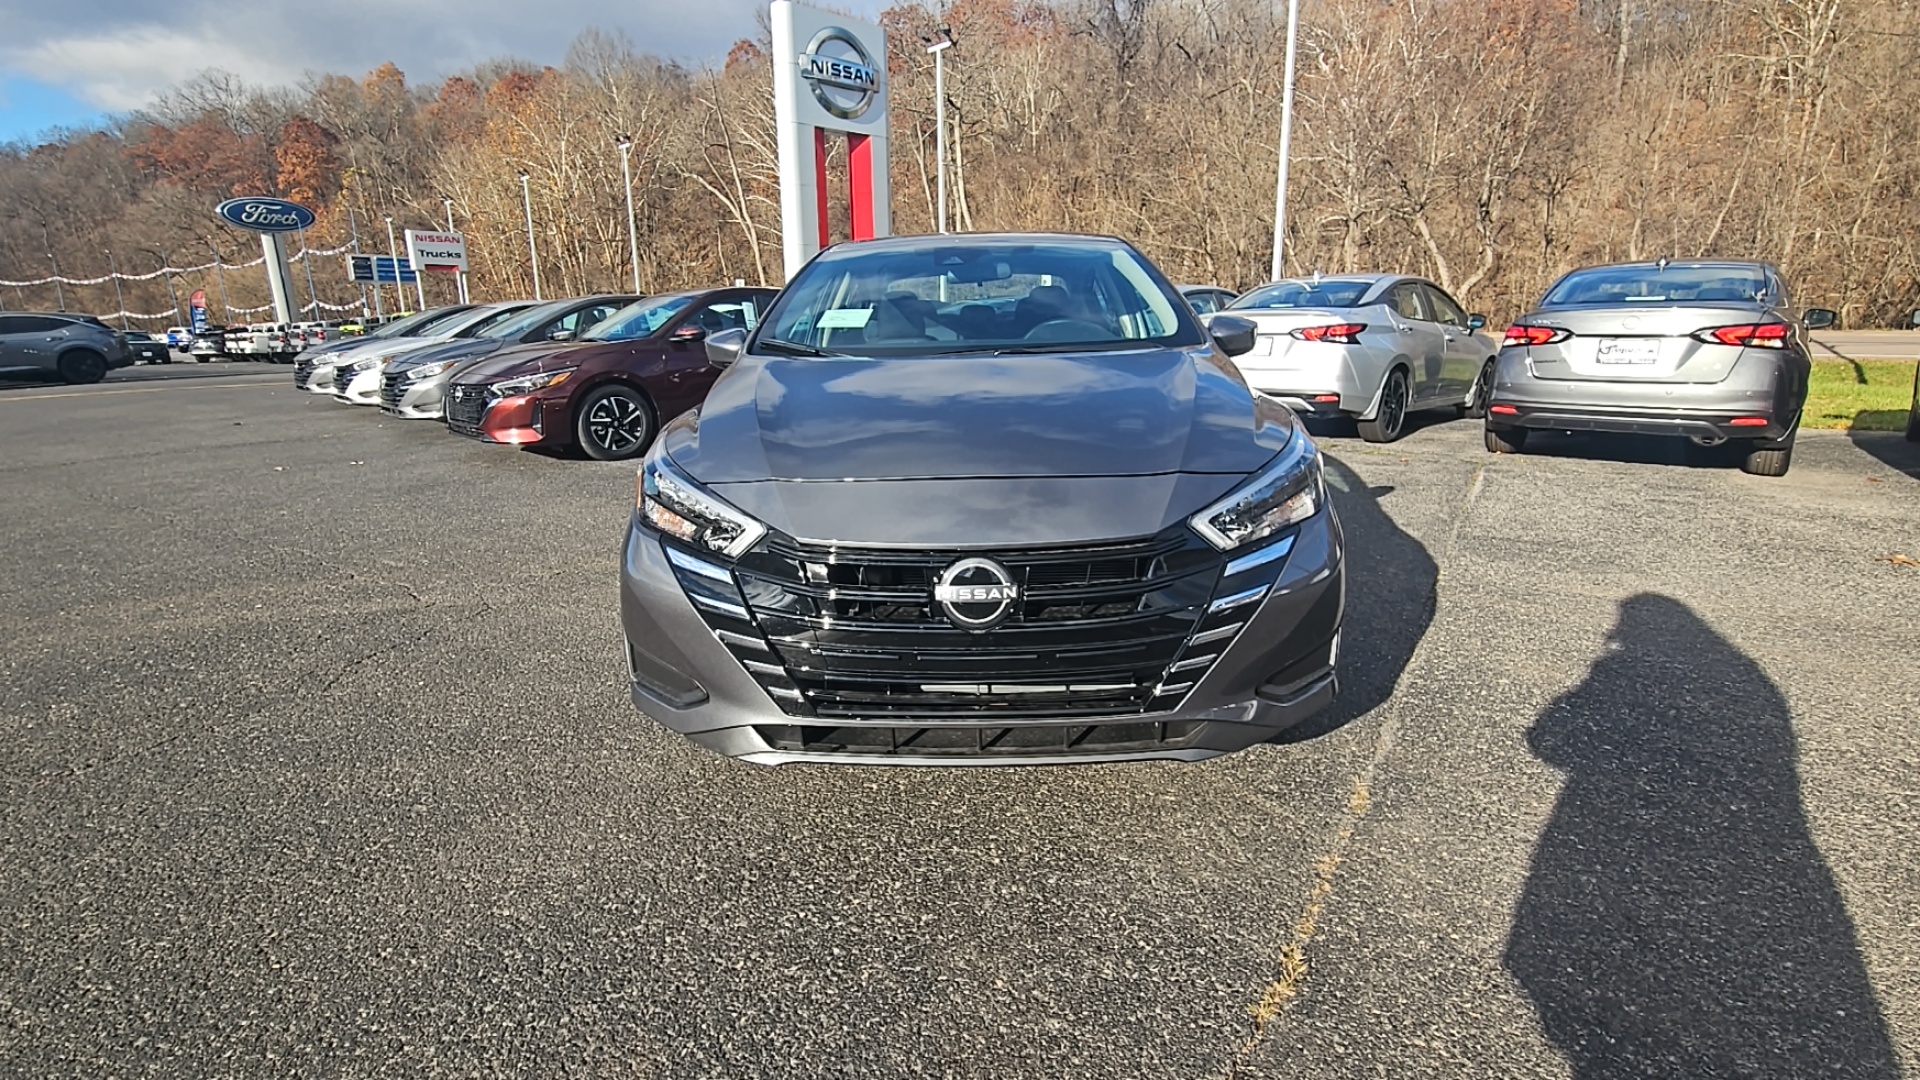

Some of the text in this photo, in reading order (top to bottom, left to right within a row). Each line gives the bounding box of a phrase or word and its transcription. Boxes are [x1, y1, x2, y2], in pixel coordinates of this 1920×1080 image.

[810, 59, 874, 86] NISSAN
[241, 203, 297, 225] Ford
[415, 235, 460, 243] NISSAN
[418, 249, 462, 258] Trucks
